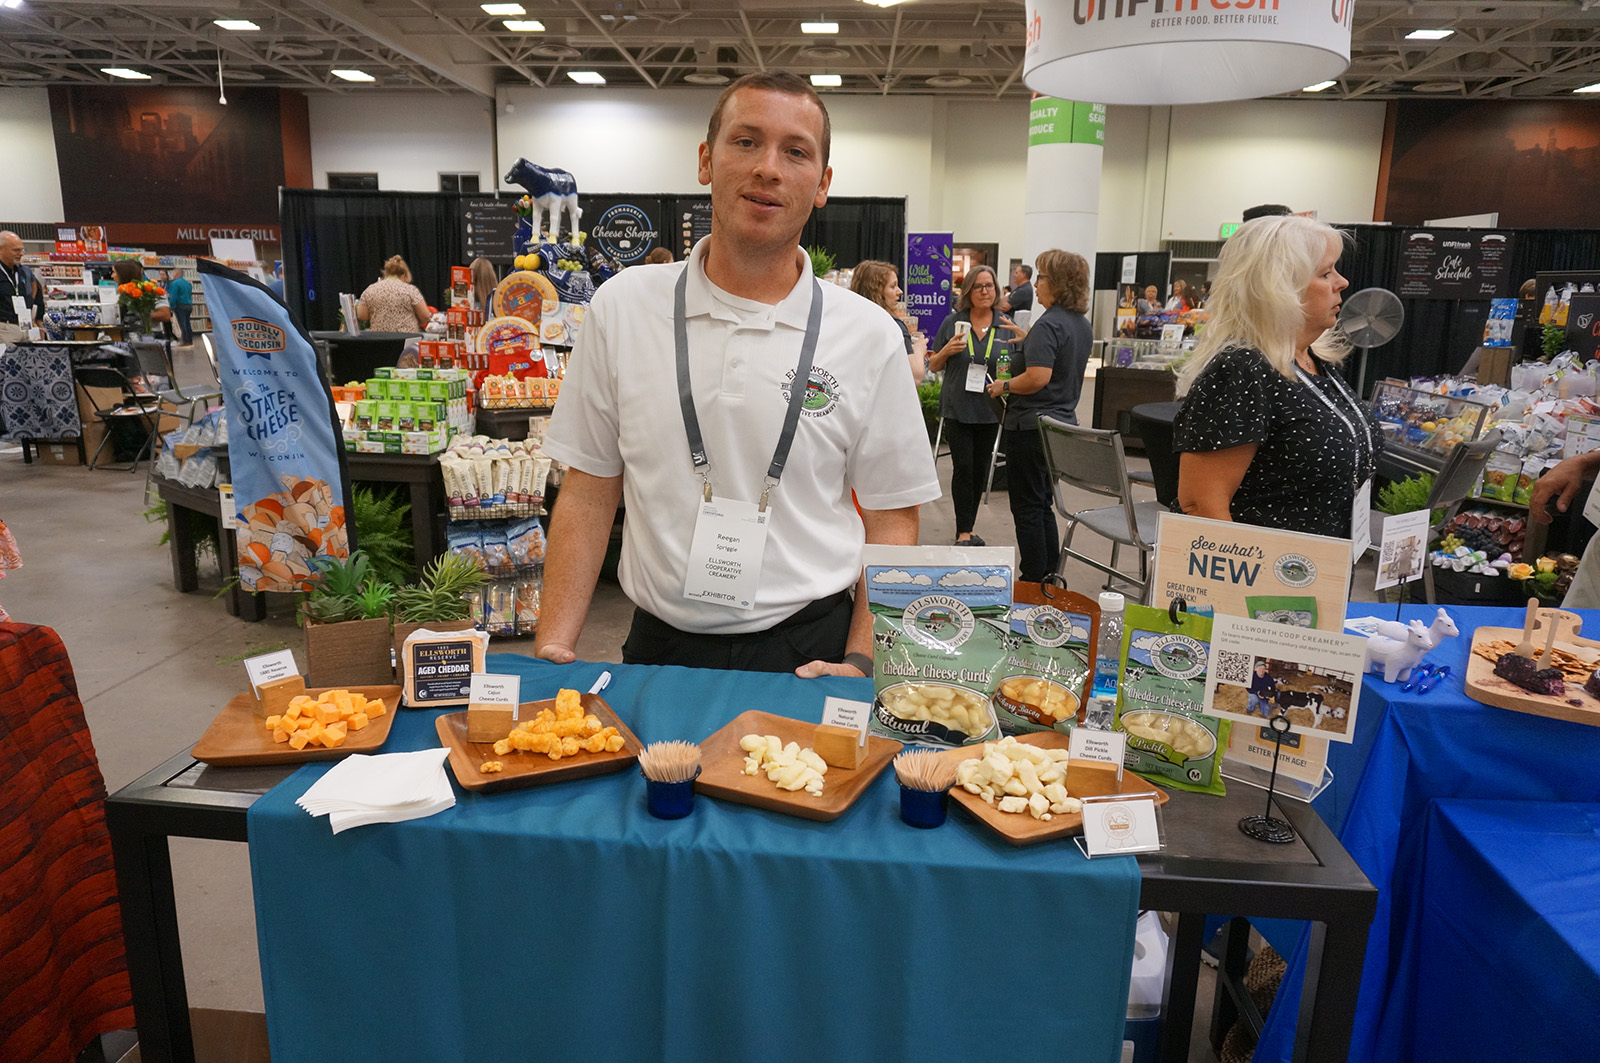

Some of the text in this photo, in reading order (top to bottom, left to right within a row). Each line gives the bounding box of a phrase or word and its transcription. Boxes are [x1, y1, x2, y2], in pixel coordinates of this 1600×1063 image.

[1151, 14, 1280, 28] BETTER FOOD. BETTER FUTURE.
[177, 228, 276, 242] MILL CITY GRILL
[592, 225, 658, 241] Cheese Shoppe
[1442, 255, 1463, 269] Café
[909, 264, 930, 276] Wild
[1434, 267, 1473, 280] Schedule
[231, 321, 281, 338] PROUDLY
[237, 338, 281, 349] WISCONSIN
[231, 368, 279, 377] WELCOME
[240, 389, 286, 423] STATE
[246, 404, 298, 441] CHEESE
[717, 533, 741, 543] Reegan
[1191, 535, 1265, 560] See what's
[705, 563, 743, 575] COOPERATIVE
[708, 557, 742, 568] ELLSWORTH
[1188, 551, 1261, 587] NEW
[708, 570, 737, 580] CREAMERY
[703, 590, 736, 602] EXHIBITOR
[1166, 581, 1208, 597] GREAT ON THE
[1166, 590, 1174, 598] GO
[907, 596, 969, 617] ELLSWORTH
[1231, 623, 1278, 636] ELLSWORTH
[1279, 630, 1300, 640] COOP
[419, 648, 467, 657] ELLSWORTH
[1155, 635, 1205, 656] ELLSWORTH
[418, 664, 470, 676] AGED CHEDDAR
[882, 661, 993, 683] Cheddar Cheese Curds
[1128, 688, 1203, 712] Cheddar Cheese Cur
[1018, 704, 1041, 719] Bacon
[1134, 739, 1168, 754] Pickle
[1247, 744, 1272, 758] BETTER
[1291, 757, 1307, 768] AGE!
